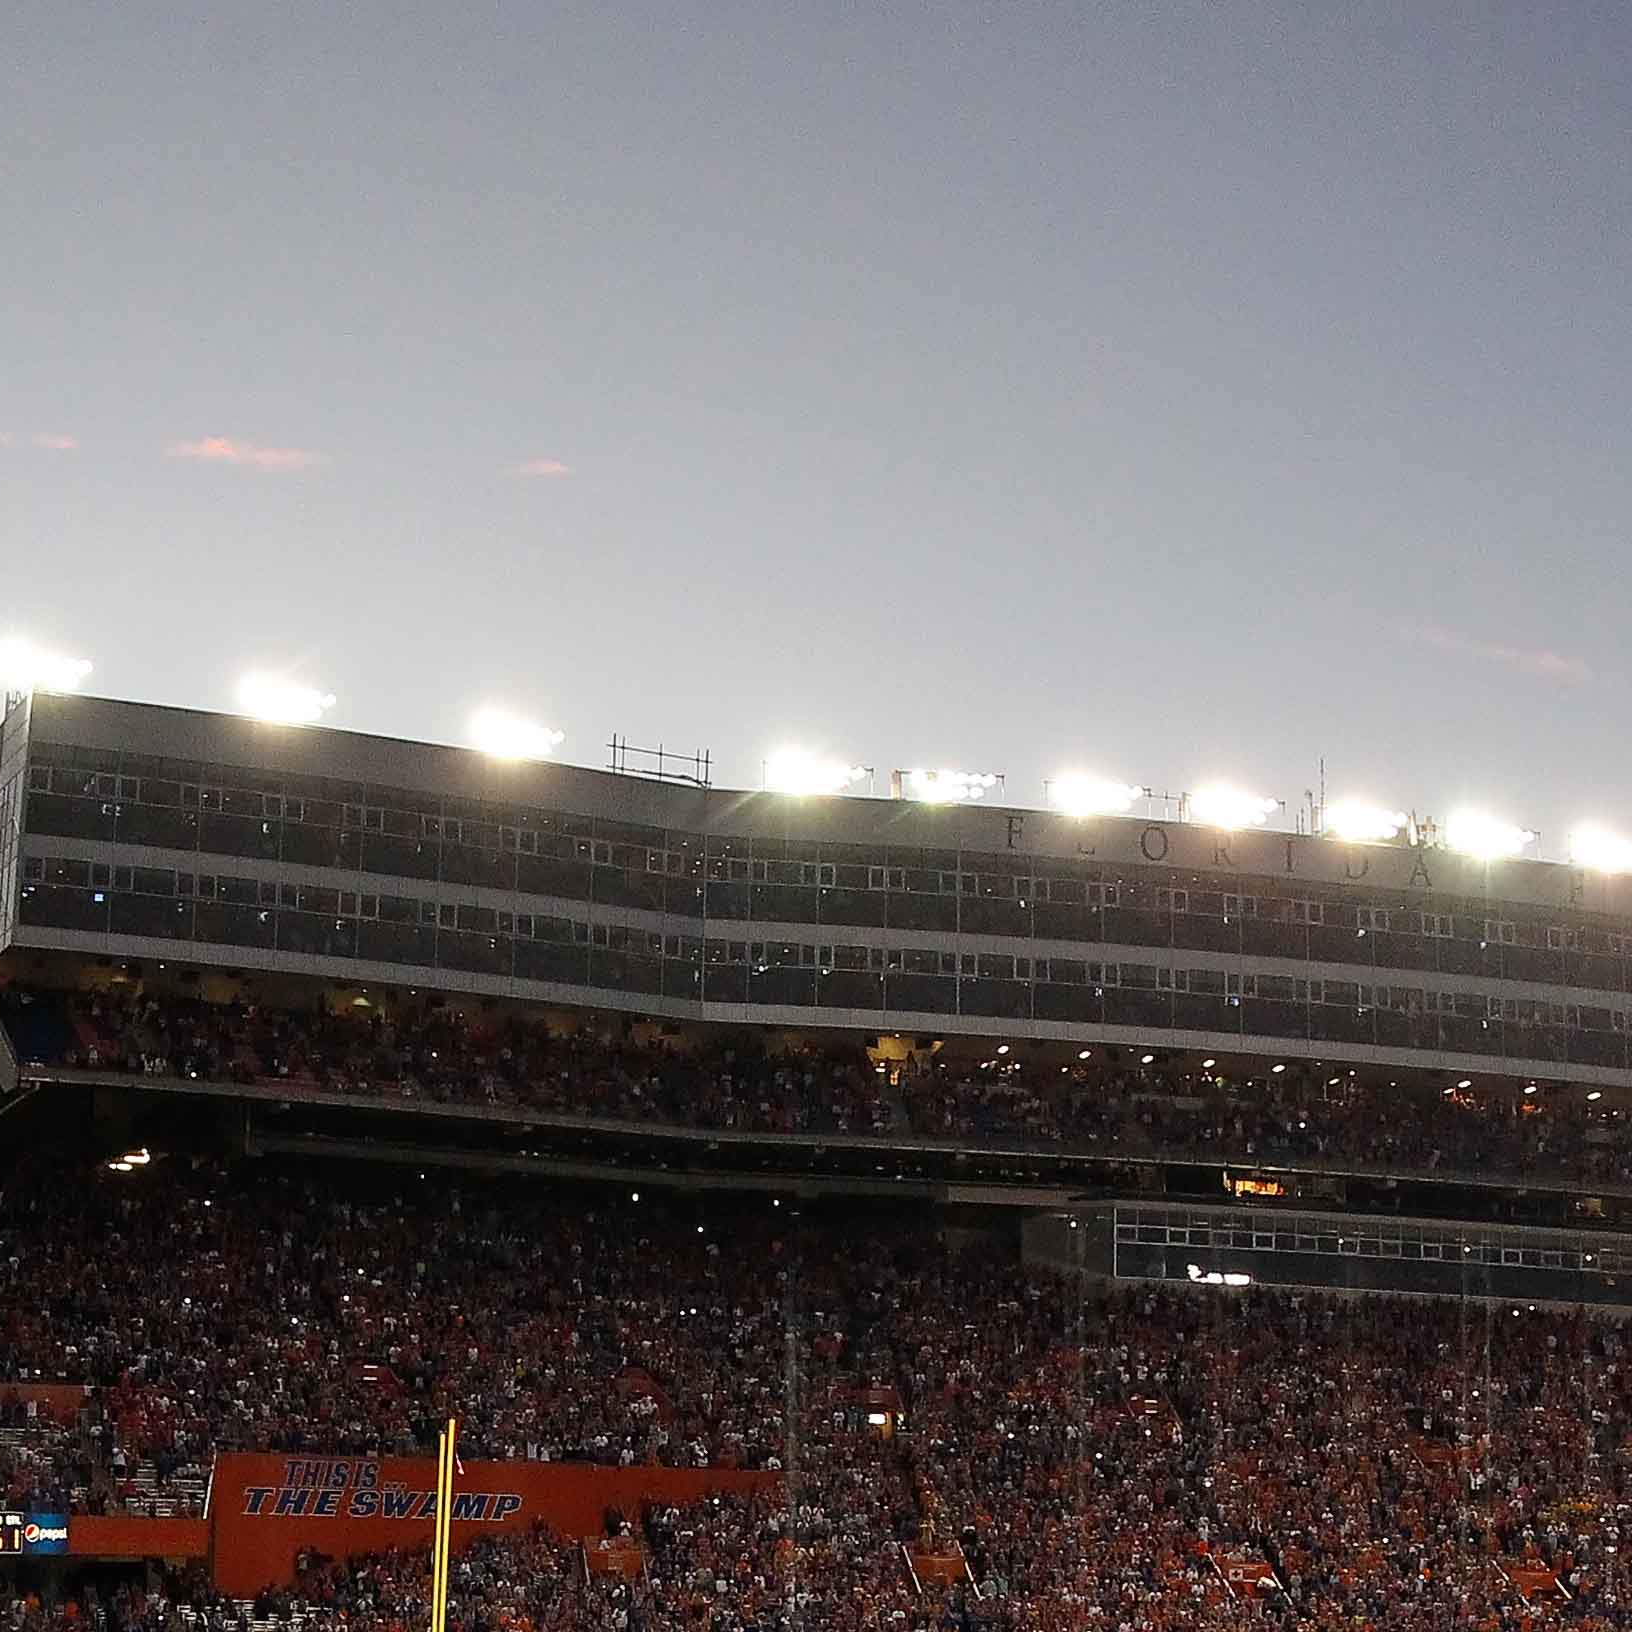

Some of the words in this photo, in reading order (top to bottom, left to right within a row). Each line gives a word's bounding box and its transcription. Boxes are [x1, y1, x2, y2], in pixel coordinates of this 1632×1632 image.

[284, 1460, 350, 1488] THIS
[242, 1487, 344, 1516] THE
[347, 1489, 522, 1521] SWAMP
[40, 1528, 68, 1541] pepsi
